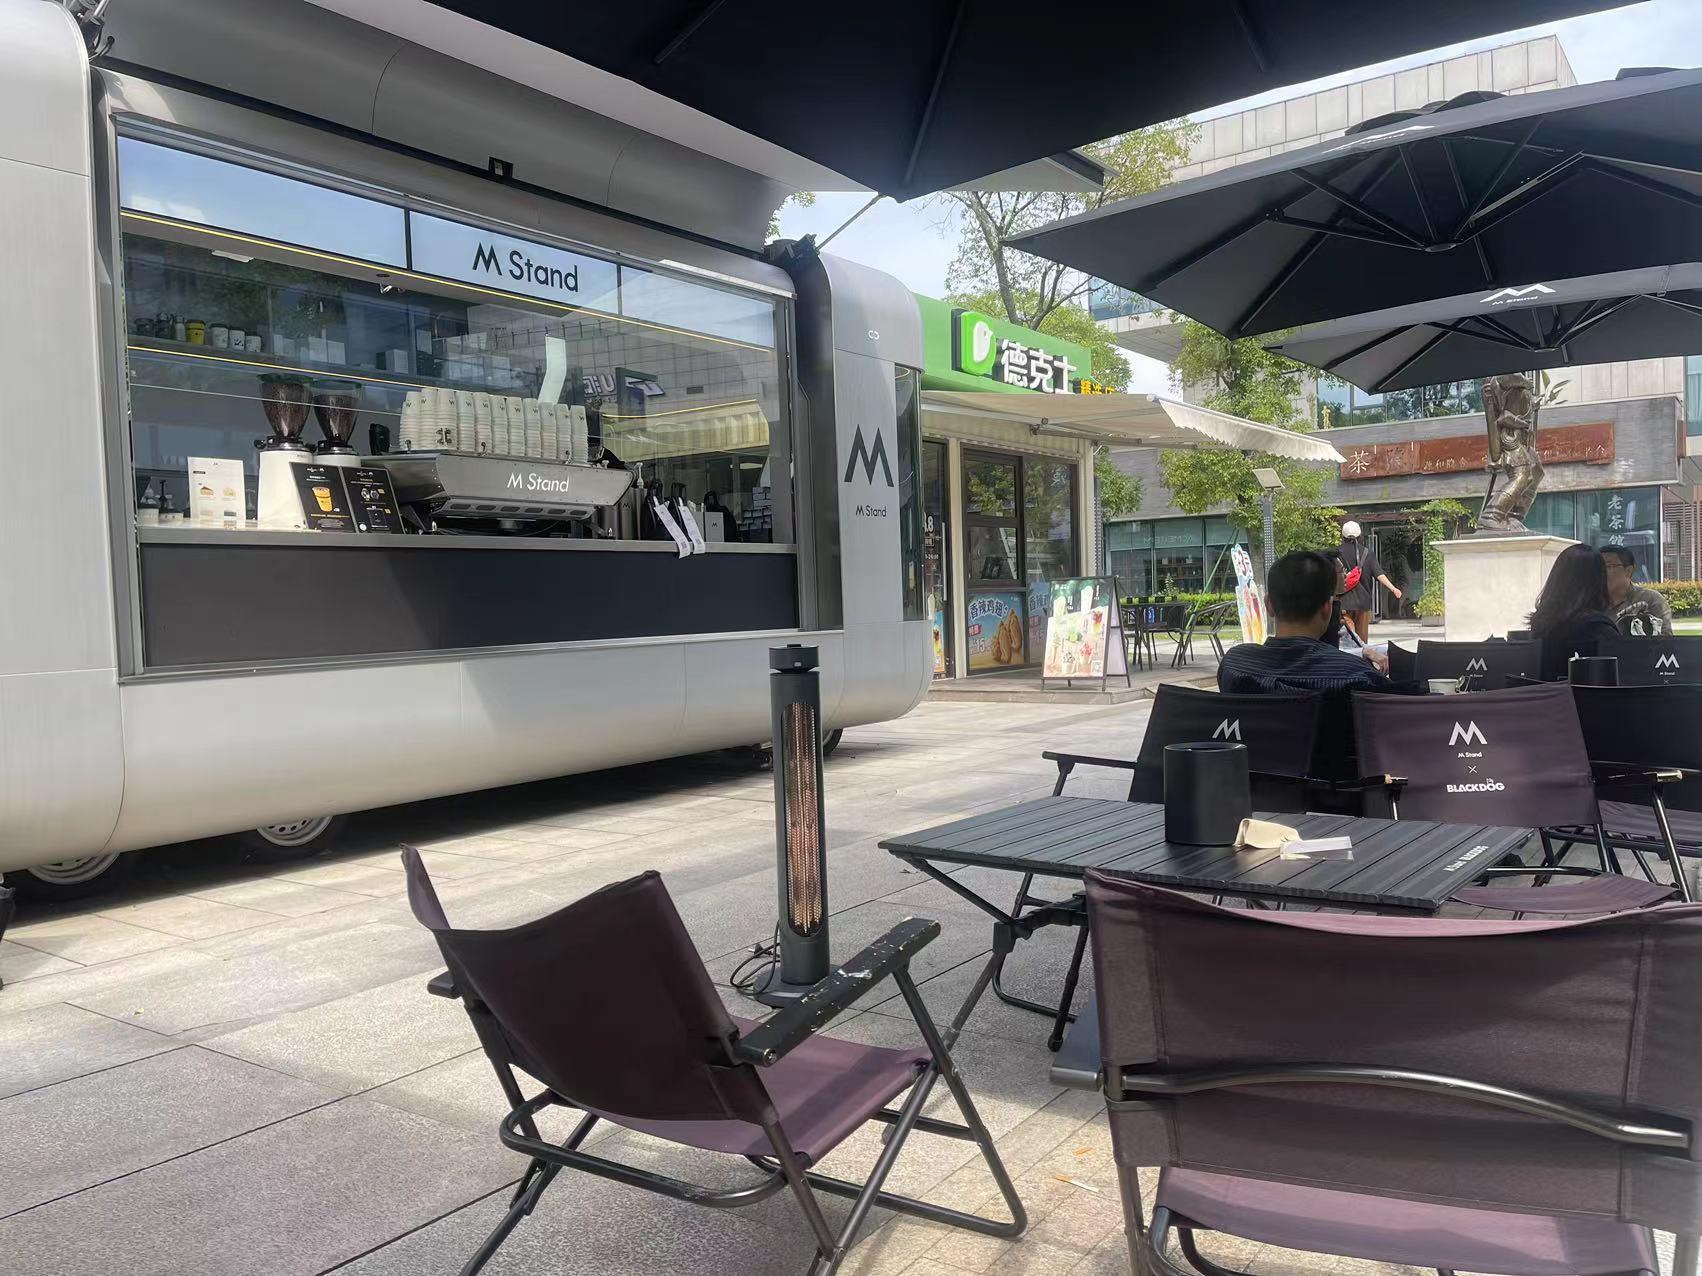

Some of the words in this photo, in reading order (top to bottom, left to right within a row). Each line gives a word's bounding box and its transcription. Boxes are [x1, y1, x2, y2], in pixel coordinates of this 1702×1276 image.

[472, 241, 503, 276] M
[508, 250, 579, 292] Stand
[1001, 339, 1077, 394] 德克士
[843, 423, 895, 488] M
[507, 472, 523, 489] M
[526, 472, 570, 493] Stand
[855, 504, 865, 516] M
[865, 504, 887, 517] Stand
[1448, 720, 1488, 746] M
[1446, 780, 1505, 793] BLACKDOG
